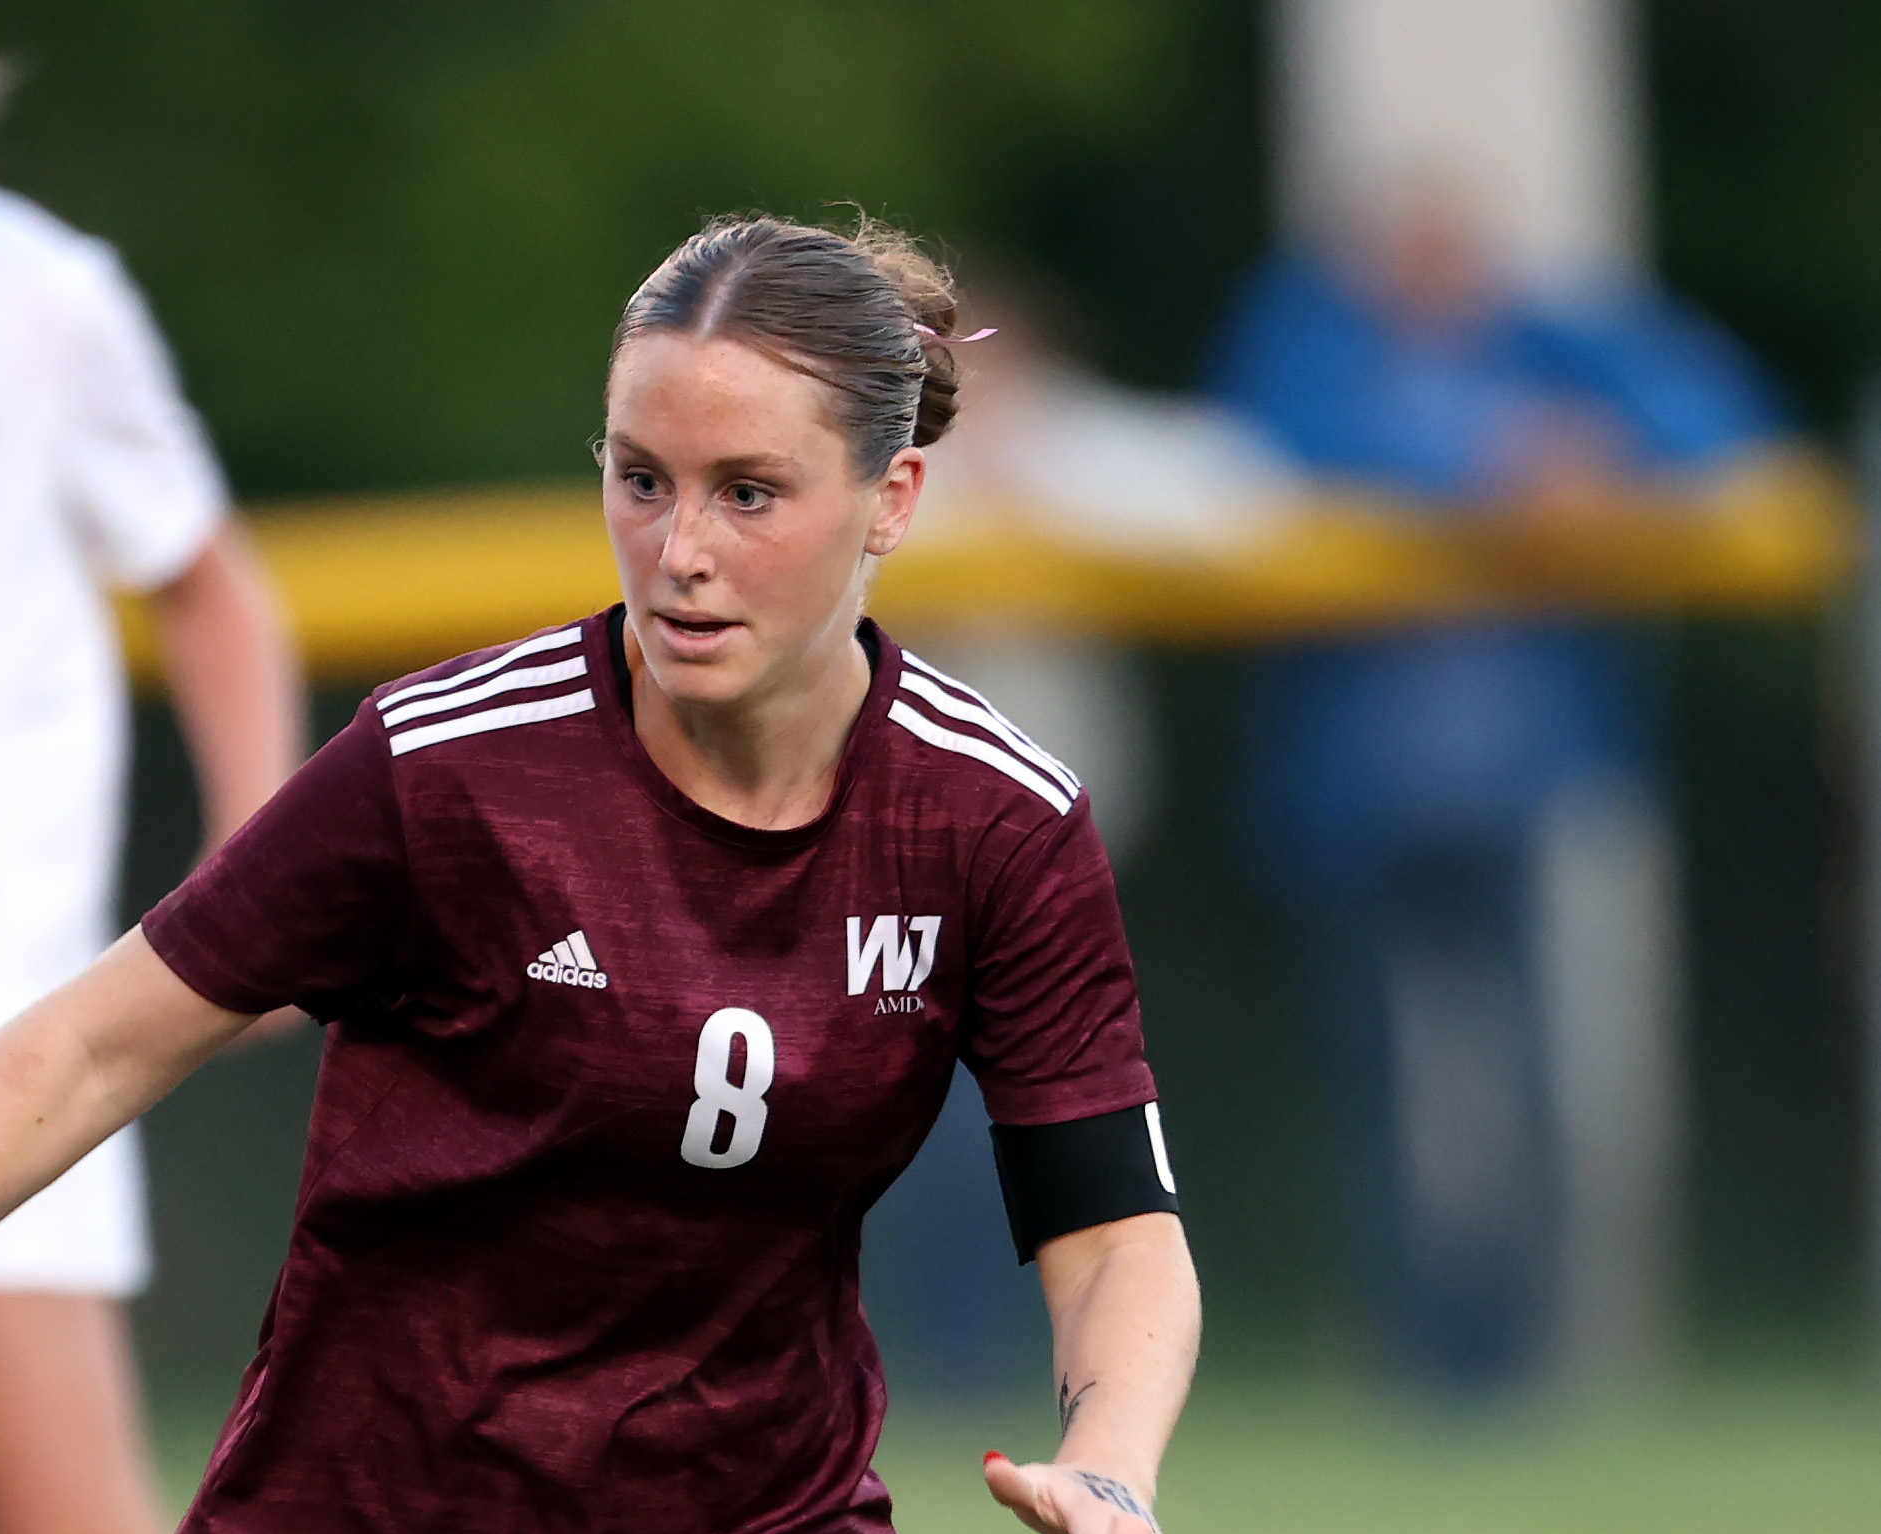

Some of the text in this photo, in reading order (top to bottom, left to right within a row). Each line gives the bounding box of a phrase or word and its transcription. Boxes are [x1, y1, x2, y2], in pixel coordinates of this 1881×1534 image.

[526, 962, 607, 989] adidas
[874, 995, 925, 1015] AMD
[681, 1007, 775, 1169] 8
